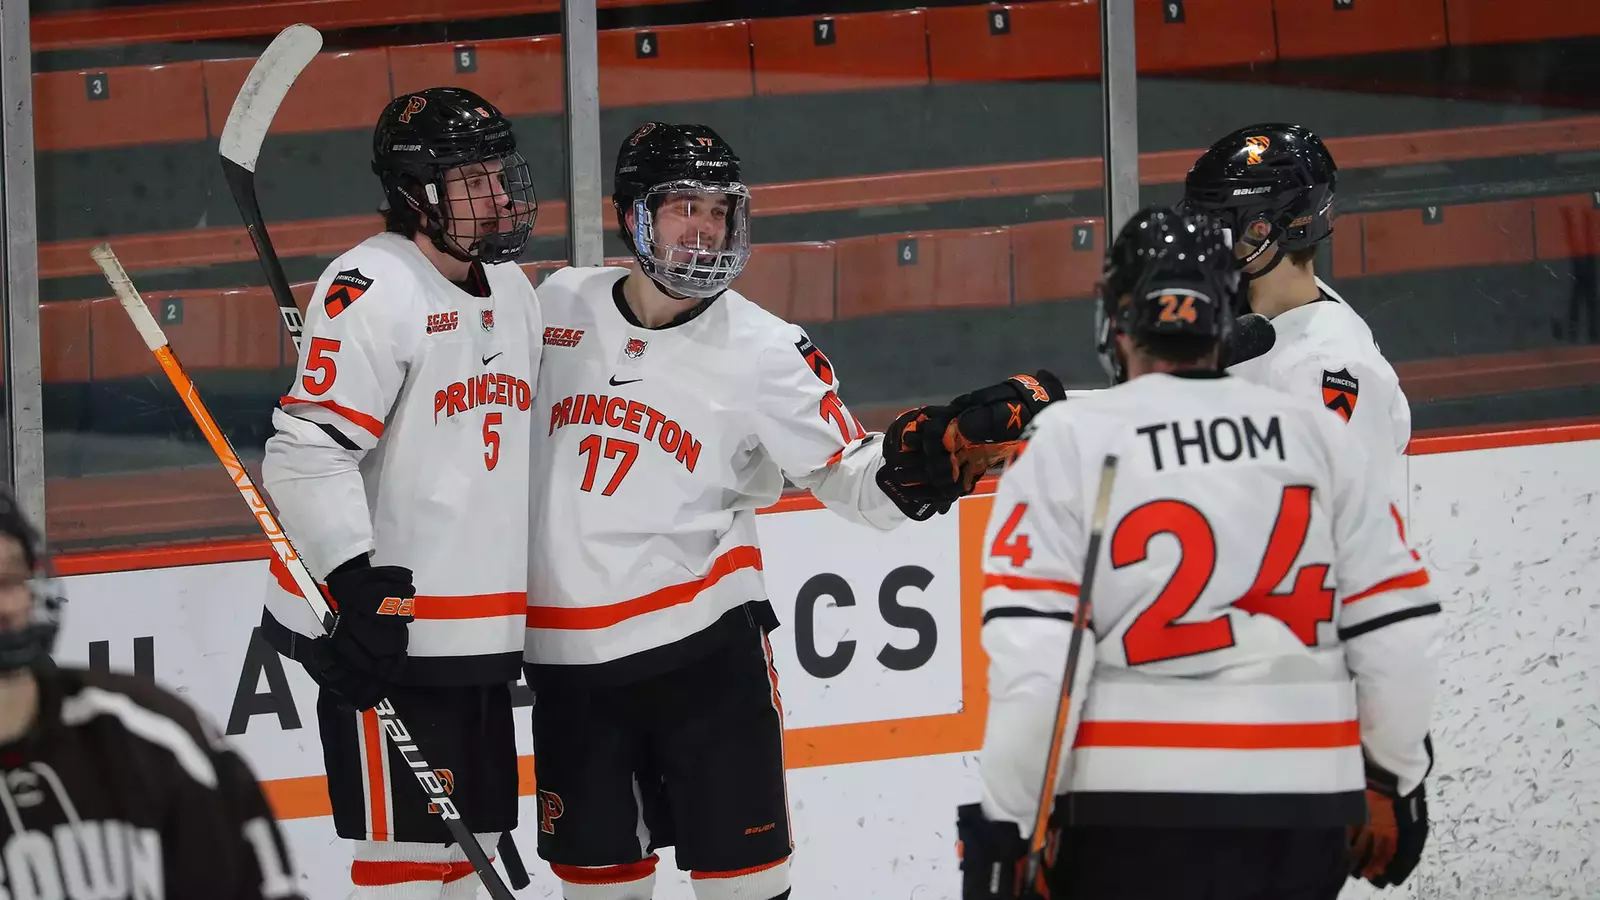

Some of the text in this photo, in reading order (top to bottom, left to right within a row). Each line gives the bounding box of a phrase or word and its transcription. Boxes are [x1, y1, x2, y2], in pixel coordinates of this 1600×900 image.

[1167, 3, 1179, 19] 9
[994, 14, 1004, 30] 8
[819, 24, 831, 41] 7
[641, 38, 651, 54] 6
[460, 52, 470, 67] 5
[92, 79, 102, 95] 3
[399, 95, 427, 124] P
[1233, 186, 1271, 196] BAUER
[1077, 228, 1087, 245] 7
[902, 244, 912, 261] 6
[1246, 239, 1271, 262] BAUER
[336, 274, 368, 287] PRINCETON
[166, 304, 177, 319] 2
[1158, 294, 1198, 324] 24
[427, 311, 458, 326] ECAC
[544, 326, 585, 341] ECAC
[302, 337, 341, 396] 5
[1326, 375, 1357, 389] PRINCETON
[434, 373, 531, 427] PRINCETO
[482, 412, 503, 472] 5
[548, 394, 703, 474] PRINCETON
[1136, 415, 1287, 472] THOM
[578, 433, 640, 498] 17
[1110, 484, 1336, 667] 24
[373, 697, 461, 821] BAUER
[538, 789, 565, 835] P
[744, 822, 775, 835] BAUER
[0, 818, 166, 900] OWN
